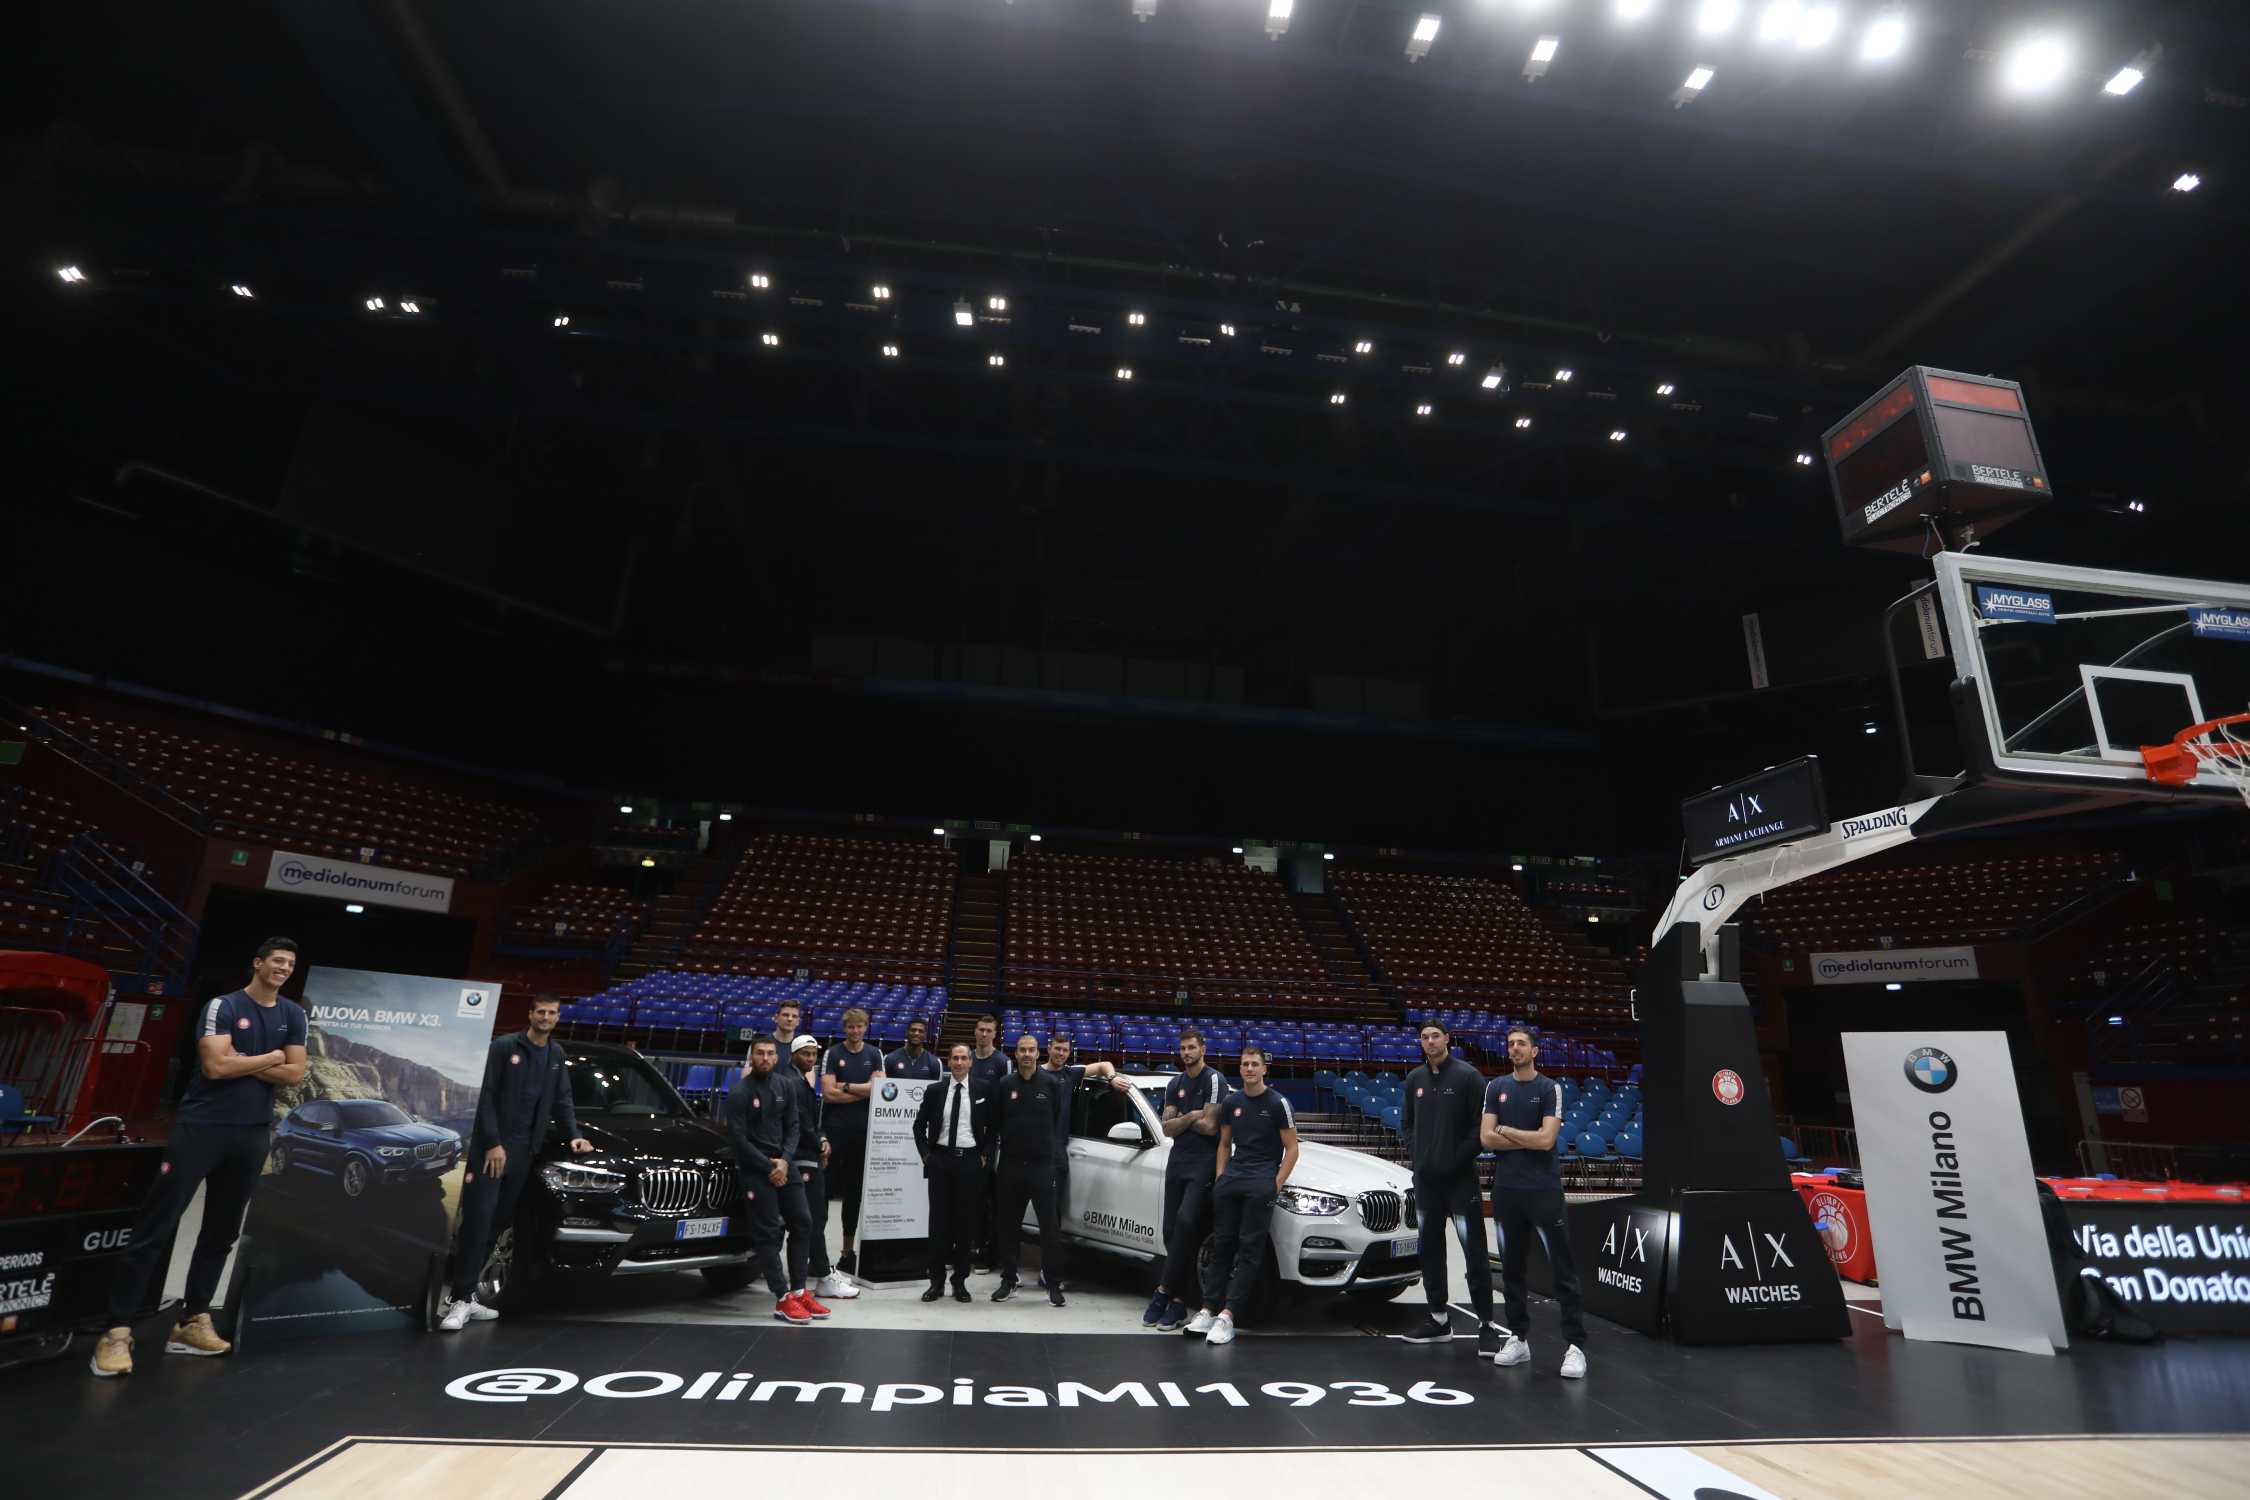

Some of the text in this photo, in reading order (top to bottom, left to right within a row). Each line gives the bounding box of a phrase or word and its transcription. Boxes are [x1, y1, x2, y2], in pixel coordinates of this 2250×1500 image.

[1993, 592, 2050, 611] MYGLASS
[2203, 612, 2250, 629] MYGLAS
[1714, 821, 1785, 848] ARMANI EXCHANGE
[1842, 808, 1909, 841] SPALDING
[279, 861, 446, 901] mediolanumforum
[1819, 957, 1969, 978] mediolanumforum
[310, 1005, 442, 1028] NUOVA BMW X3.
[874, 1107, 902, 1118] BMW
[1091, 1212, 1117, 1228] BMW
[1119, 1217, 1154, 1237] Milano
[1928, 1111, 1986, 1322] BMW Milano
[83, 1228, 133, 1250] GUE
[2073, 1224, 2250, 1259] Via della Uni
[1598, 1267, 1642, 1293] WATCHES
[2143, 1267, 2250, 1303] Donato
[1725, 1285, 1801, 1304] WATCHES
[444, 1367, 1475, 1412] @OlimpiaMI1936
